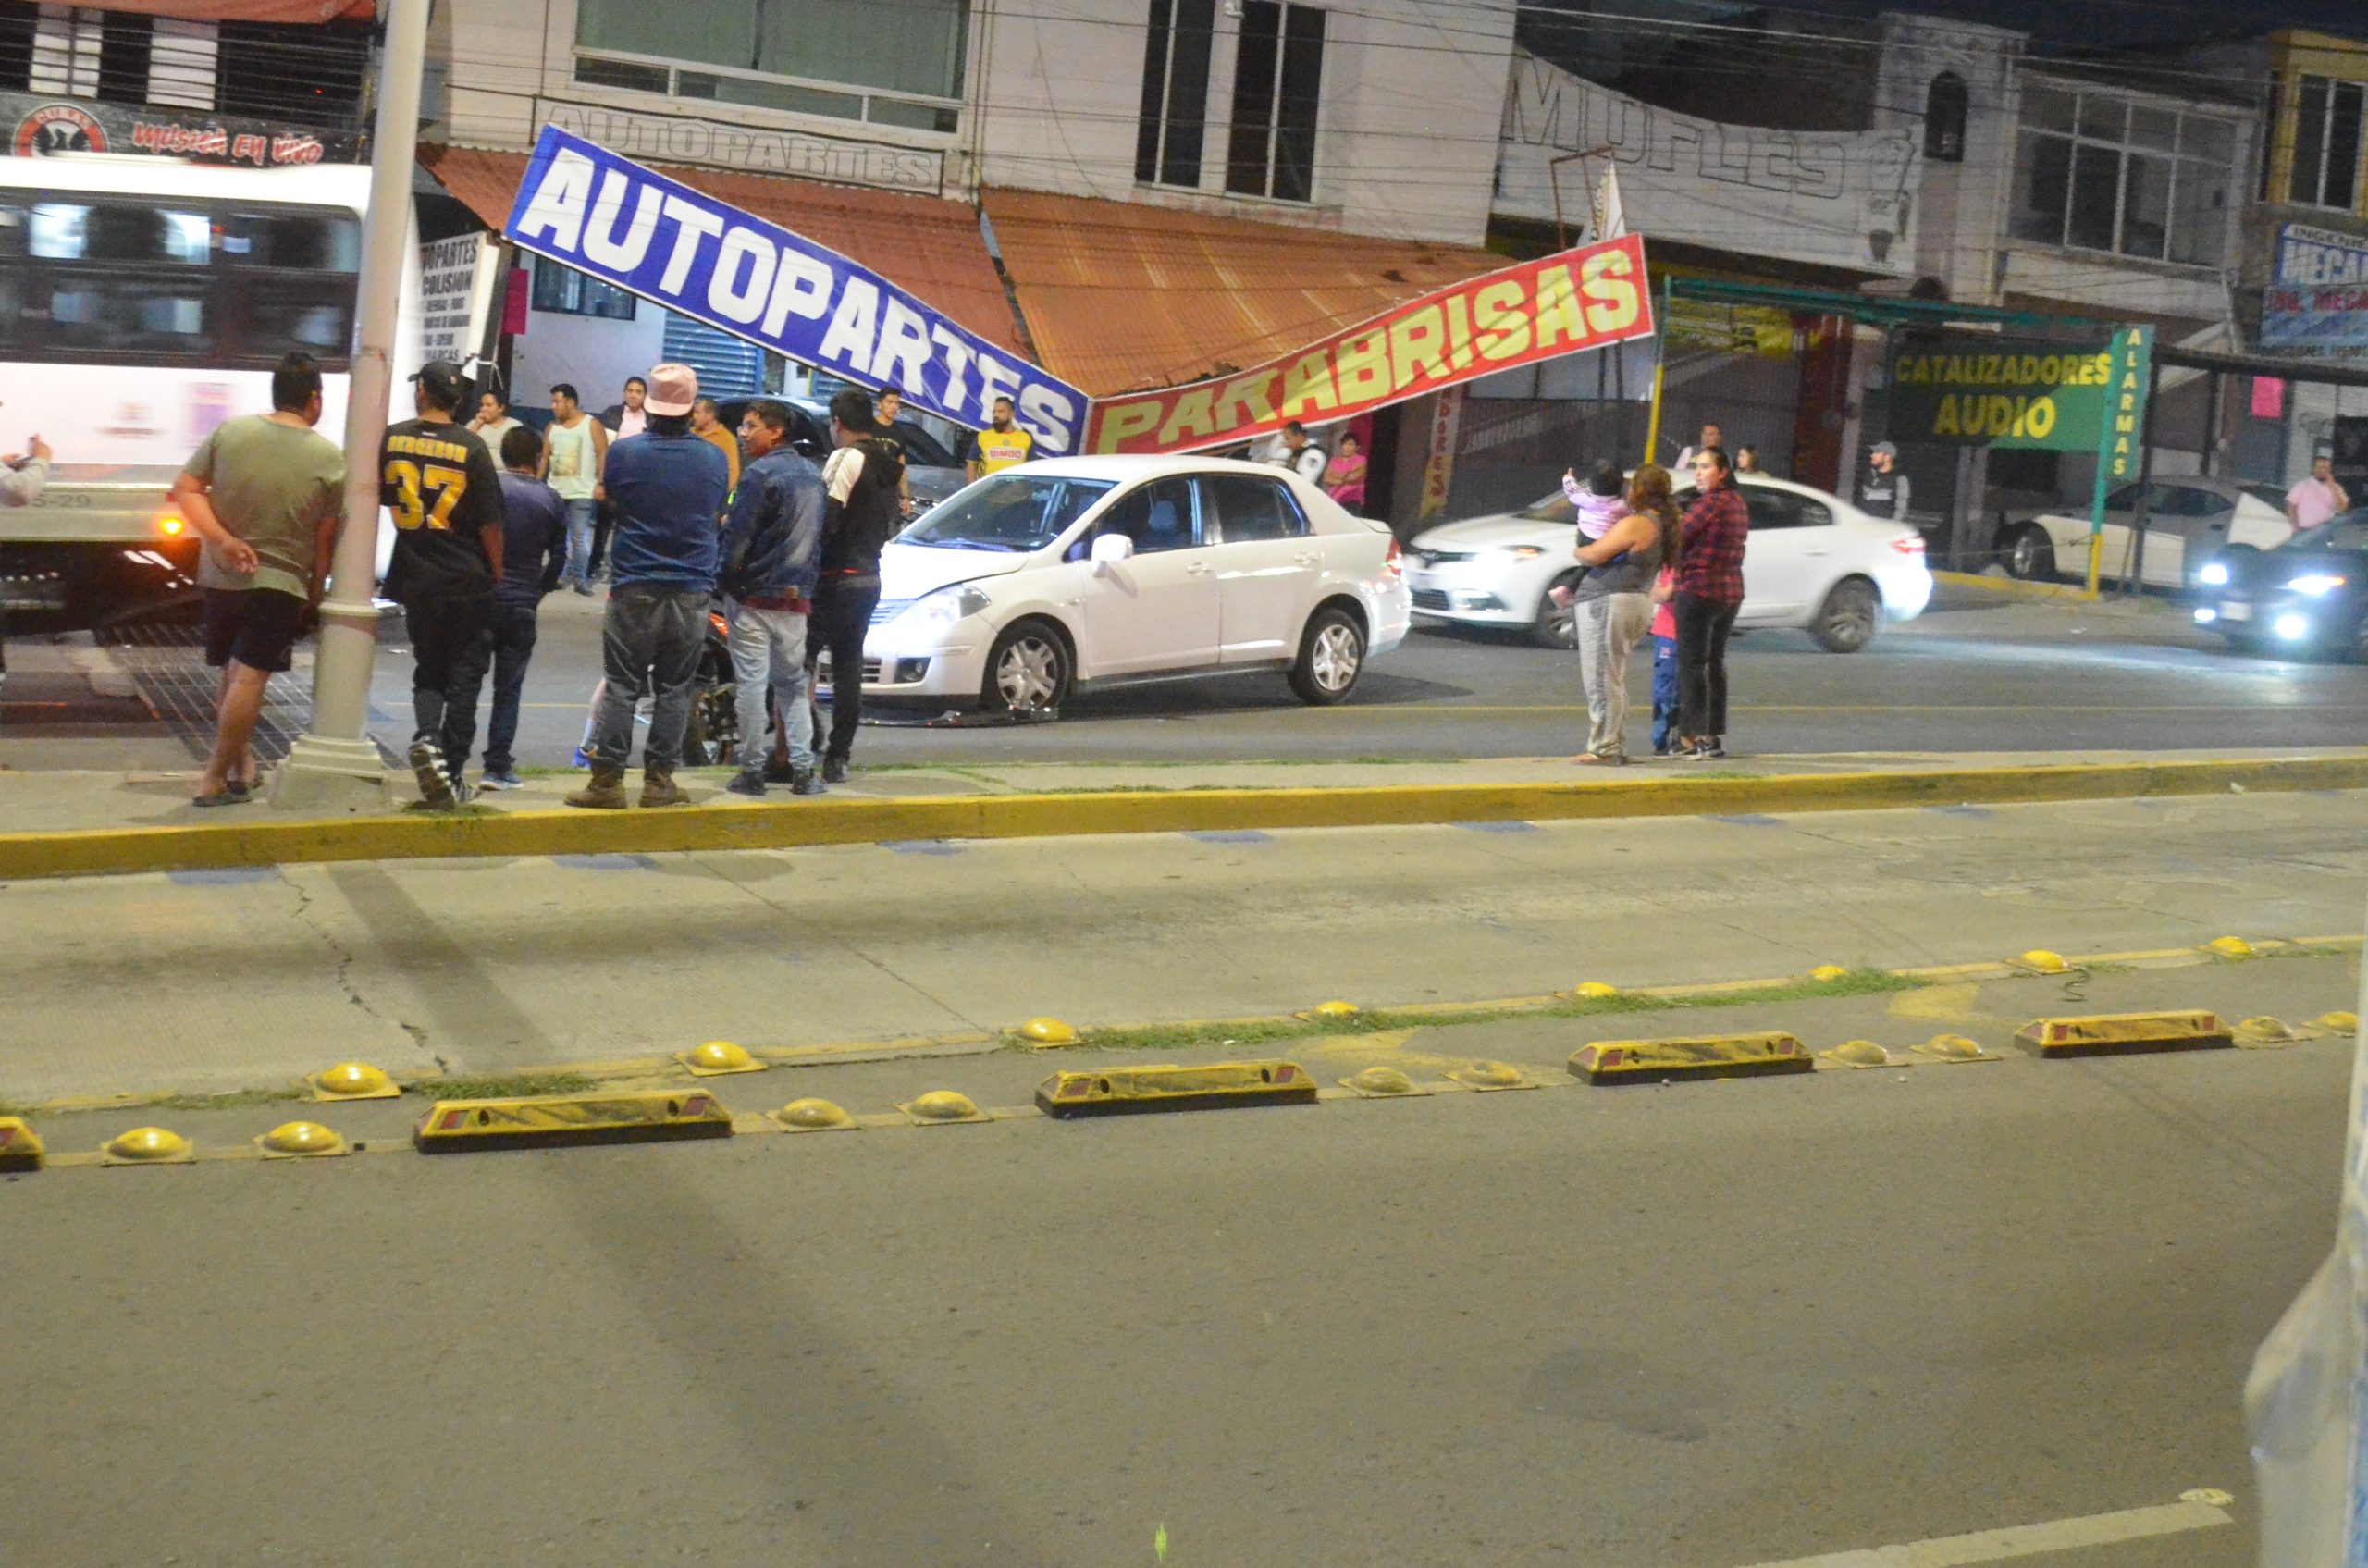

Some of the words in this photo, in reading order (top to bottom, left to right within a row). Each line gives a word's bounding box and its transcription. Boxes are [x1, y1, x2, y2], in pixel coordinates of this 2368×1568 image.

[547, 106, 934, 187] AUTOPARTES
[421, 238, 478, 270] TOPARTES
[516, 146, 1074, 455] AUTOPARTES
[1096, 248, 1640, 455] PARABRISAS
[1896, 352, 2113, 386] CATALIZADORES
[1933, 394, 2057, 439] AUDIO
[2113, 327, 2142, 475] ALARMAS
[384, 459, 468, 531] 37
